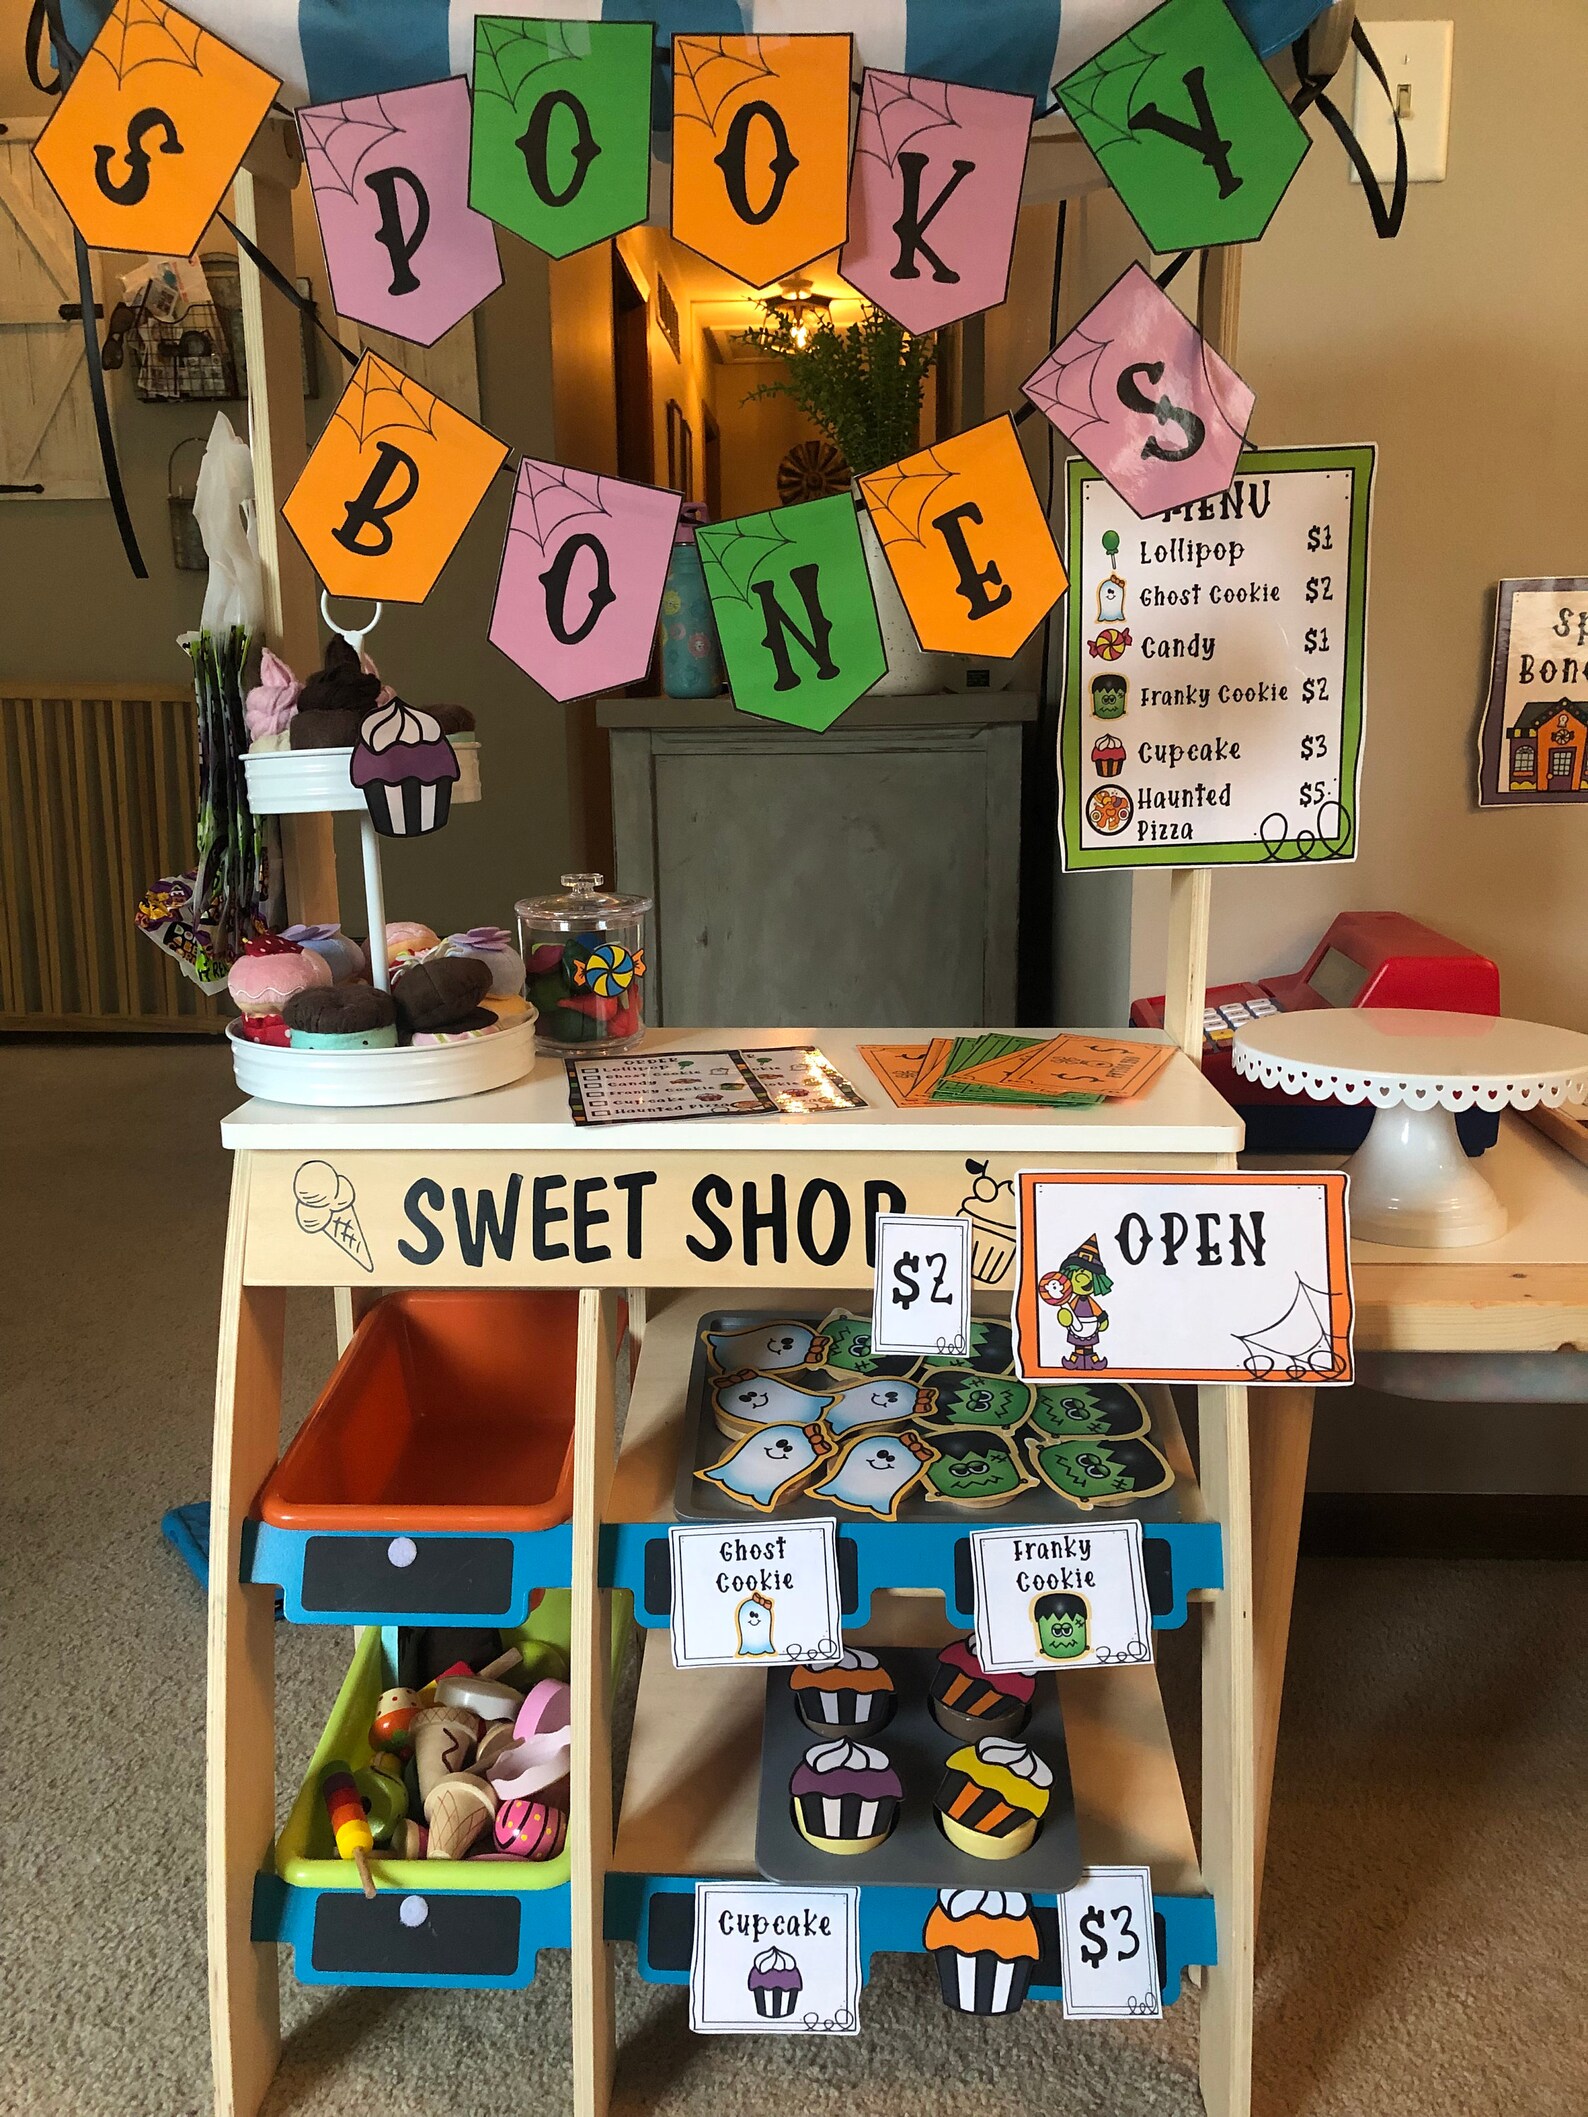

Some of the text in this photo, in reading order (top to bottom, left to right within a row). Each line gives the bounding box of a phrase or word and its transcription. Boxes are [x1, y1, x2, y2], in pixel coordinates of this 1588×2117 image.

[1140, 524, 1333, 568] Lollipop $1
[1139, 576, 1334, 607] Ghost Cookie $2
[1140, 627, 1330, 661] Candy $1
[1140, 677, 1330, 709] Franky Cookie $2
[1137, 735, 1329, 769] Cupcake $3
[1137, 781, 1326, 810] Haunted $5
[1137, 820, 1195, 842] Pizza
[603, 1065, 669, 1073] Lollipop
[624, 1057, 678, 1066] ORDER
[653, 1069, 702, 1077] Cookie
[607, 1079, 658, 1088] Candy
[665, 1085, 716, 1093] Cookie
[399, 1171, 907, 1269] SWEET SHOP
[1115, 1211, 1267, 1267] OPEN
[892, 1251, 953, 1311] $2
[719, 1536, 787, 1562] Ghost
[1013, 1535, 1092, 1562] Franky
[715, 1568, 794, 1592] Cookie
[1016, 1567, 1096, 1593] Cookie
[718, 1908, 832, 1943] Cupcake
[1079, 1905, 1140, 1969] $3
